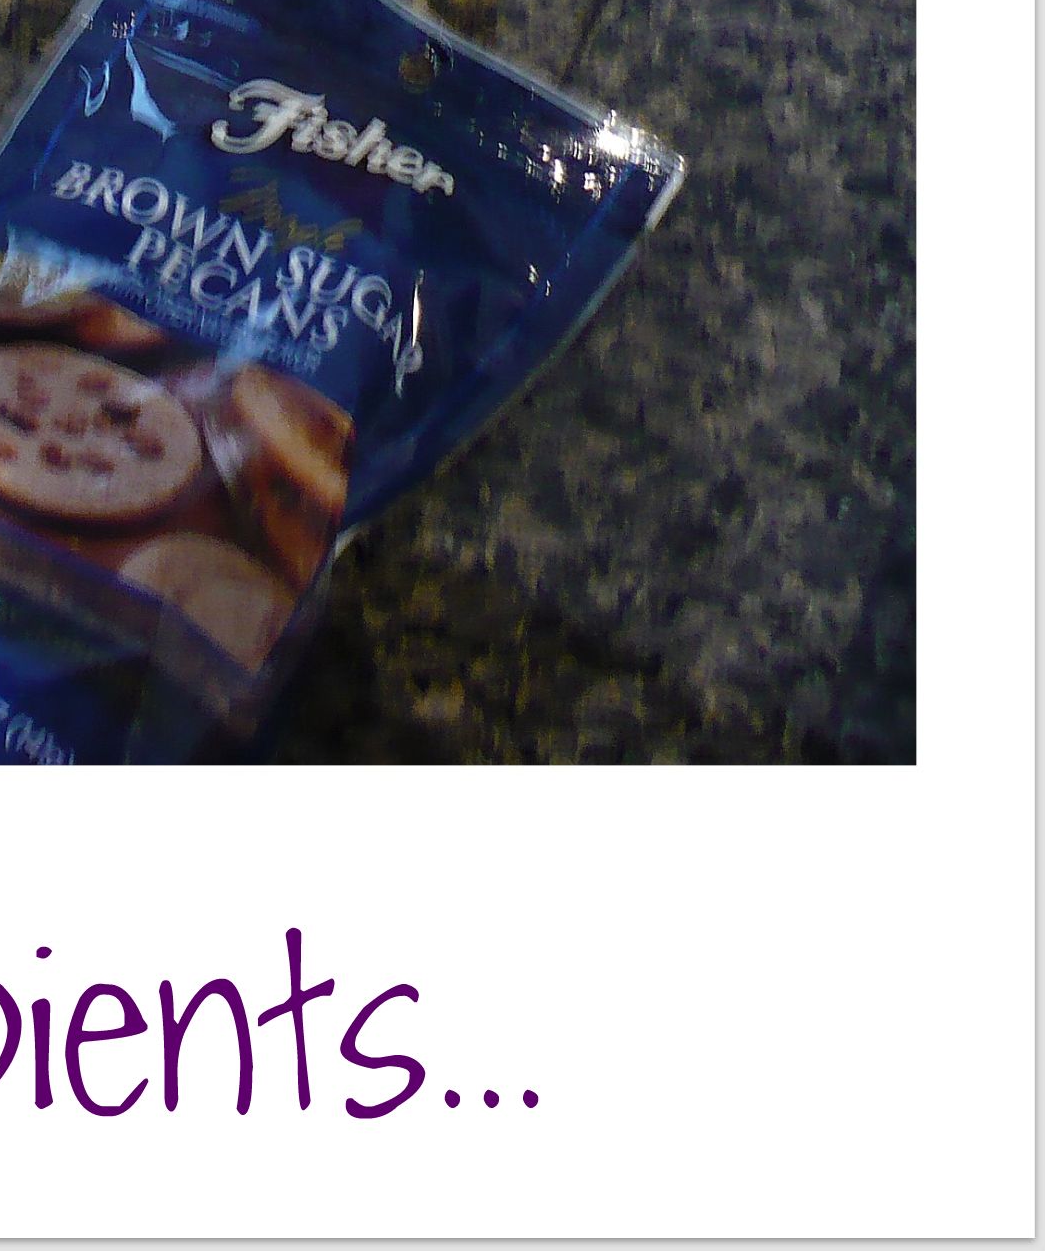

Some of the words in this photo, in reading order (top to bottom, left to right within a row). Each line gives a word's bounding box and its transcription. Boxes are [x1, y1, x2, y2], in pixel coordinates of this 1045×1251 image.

[210, 78, 455, 197] Fisher
[53, 159, 274, 277] BROWN
[126, 222, 350, 352] PECANS
